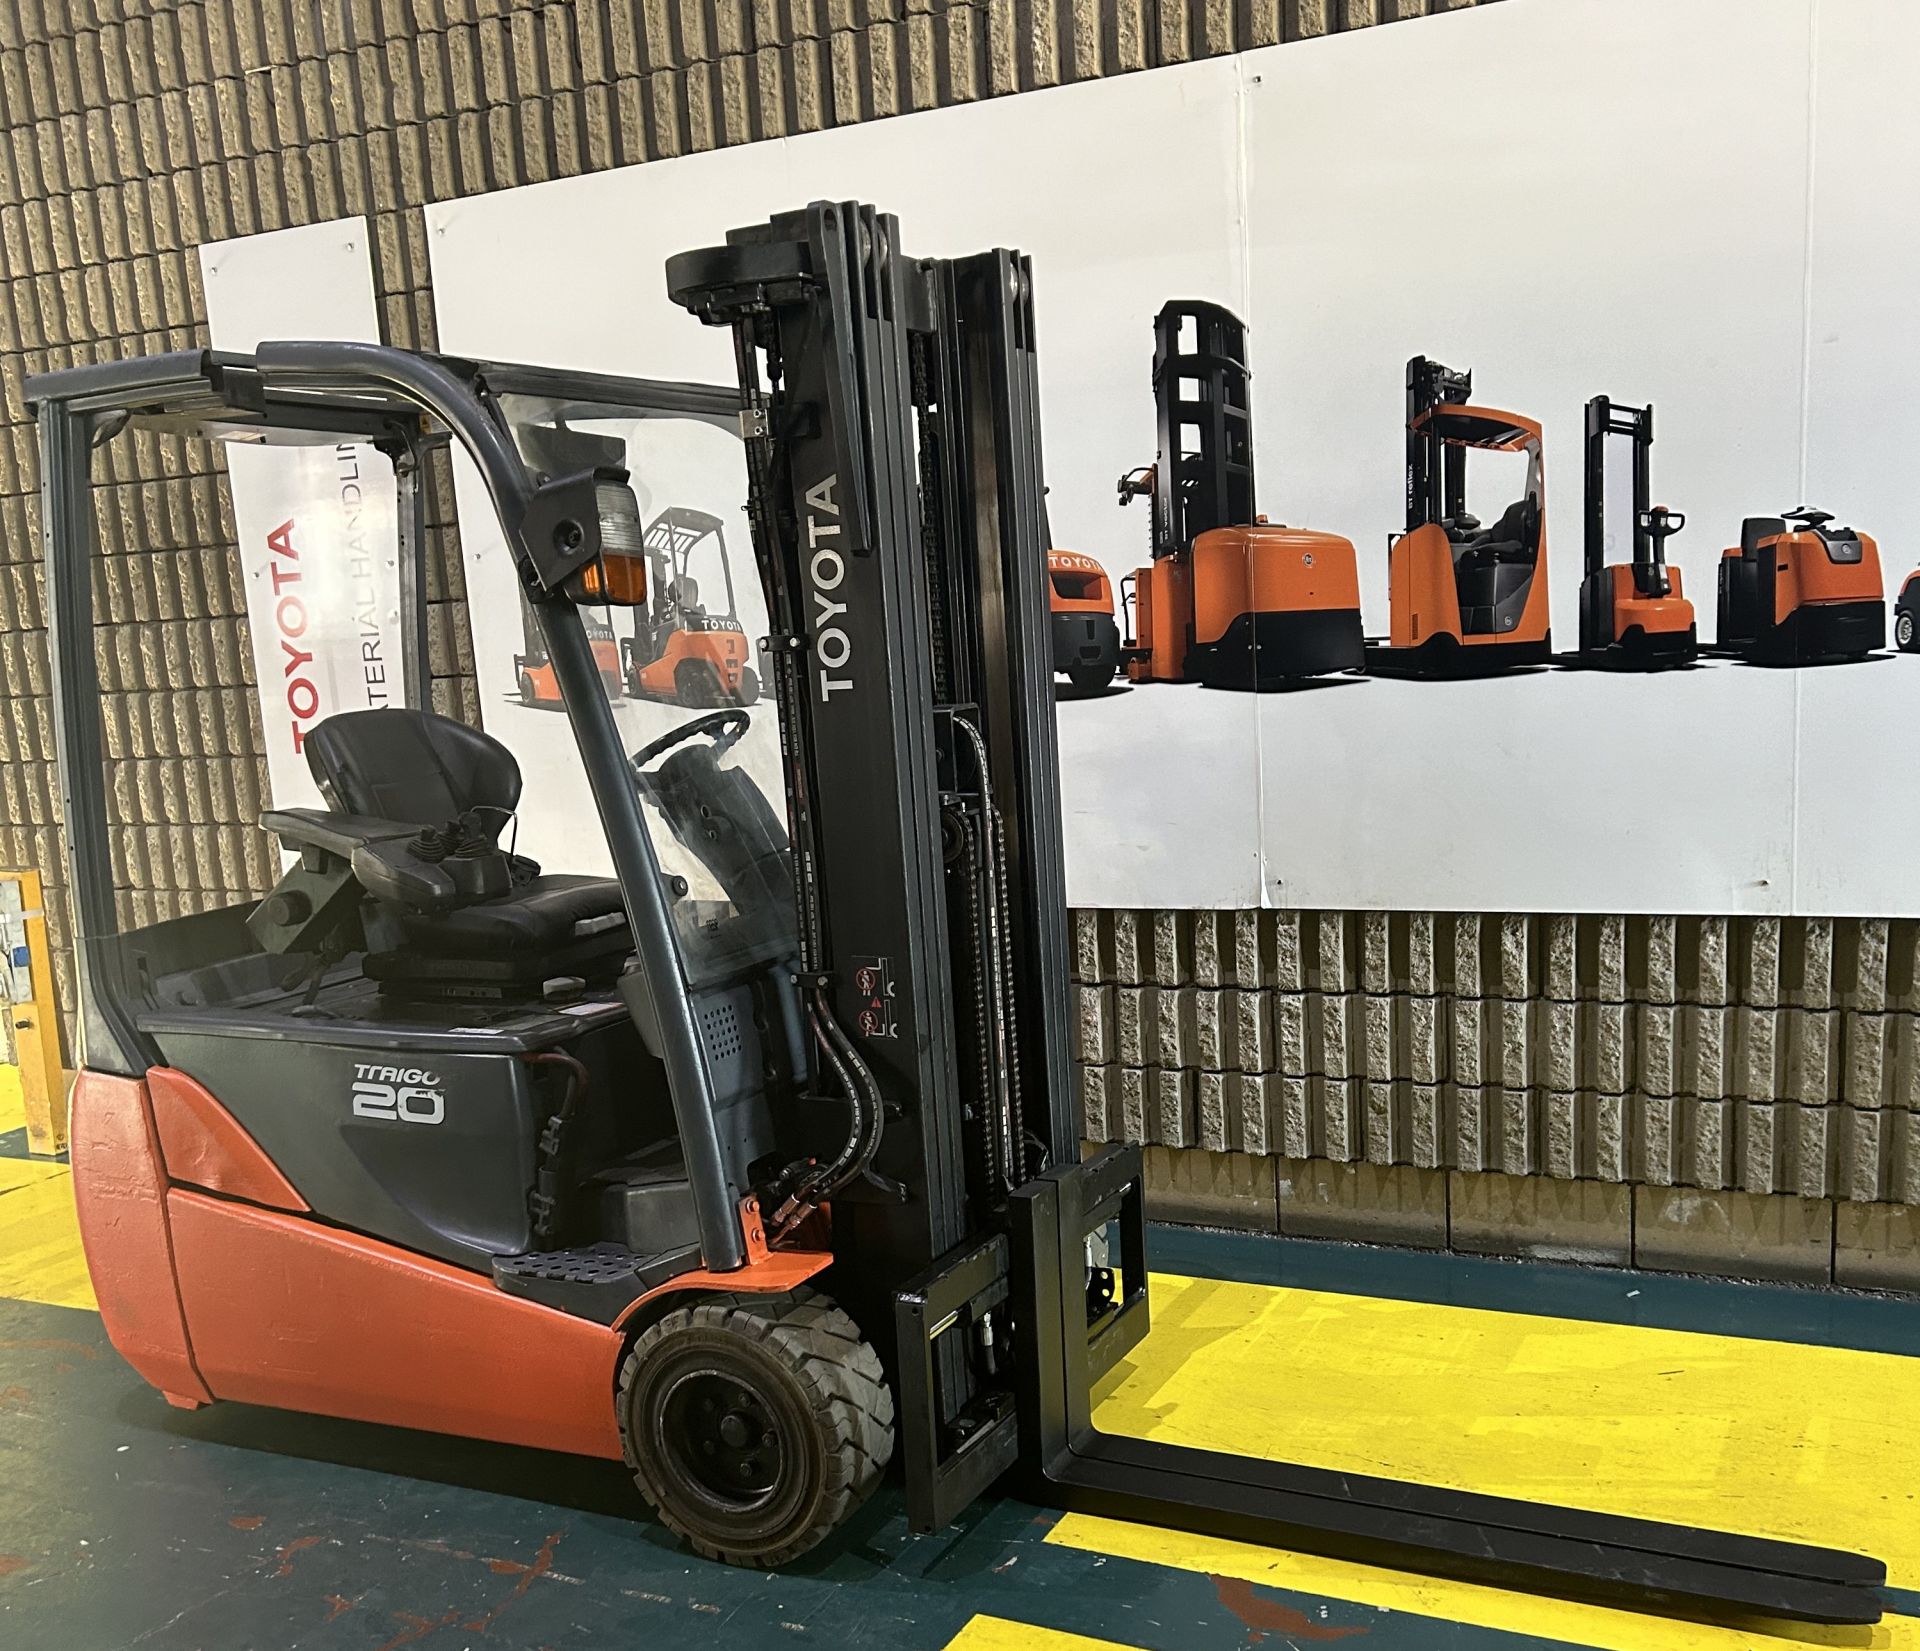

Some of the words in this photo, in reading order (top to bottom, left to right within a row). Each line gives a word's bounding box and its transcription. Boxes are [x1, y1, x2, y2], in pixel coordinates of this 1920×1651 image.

[701, 619, 742, 631] TOYOTA
[805, 473, 853, 702] TOYOTA
[267, 518, 320, 755] TOYOTA
[357, 588, 388, 710] TERIAL
[586, 630, 613, 640] OYOTA
[352, 1082, 446, 1125] 20
